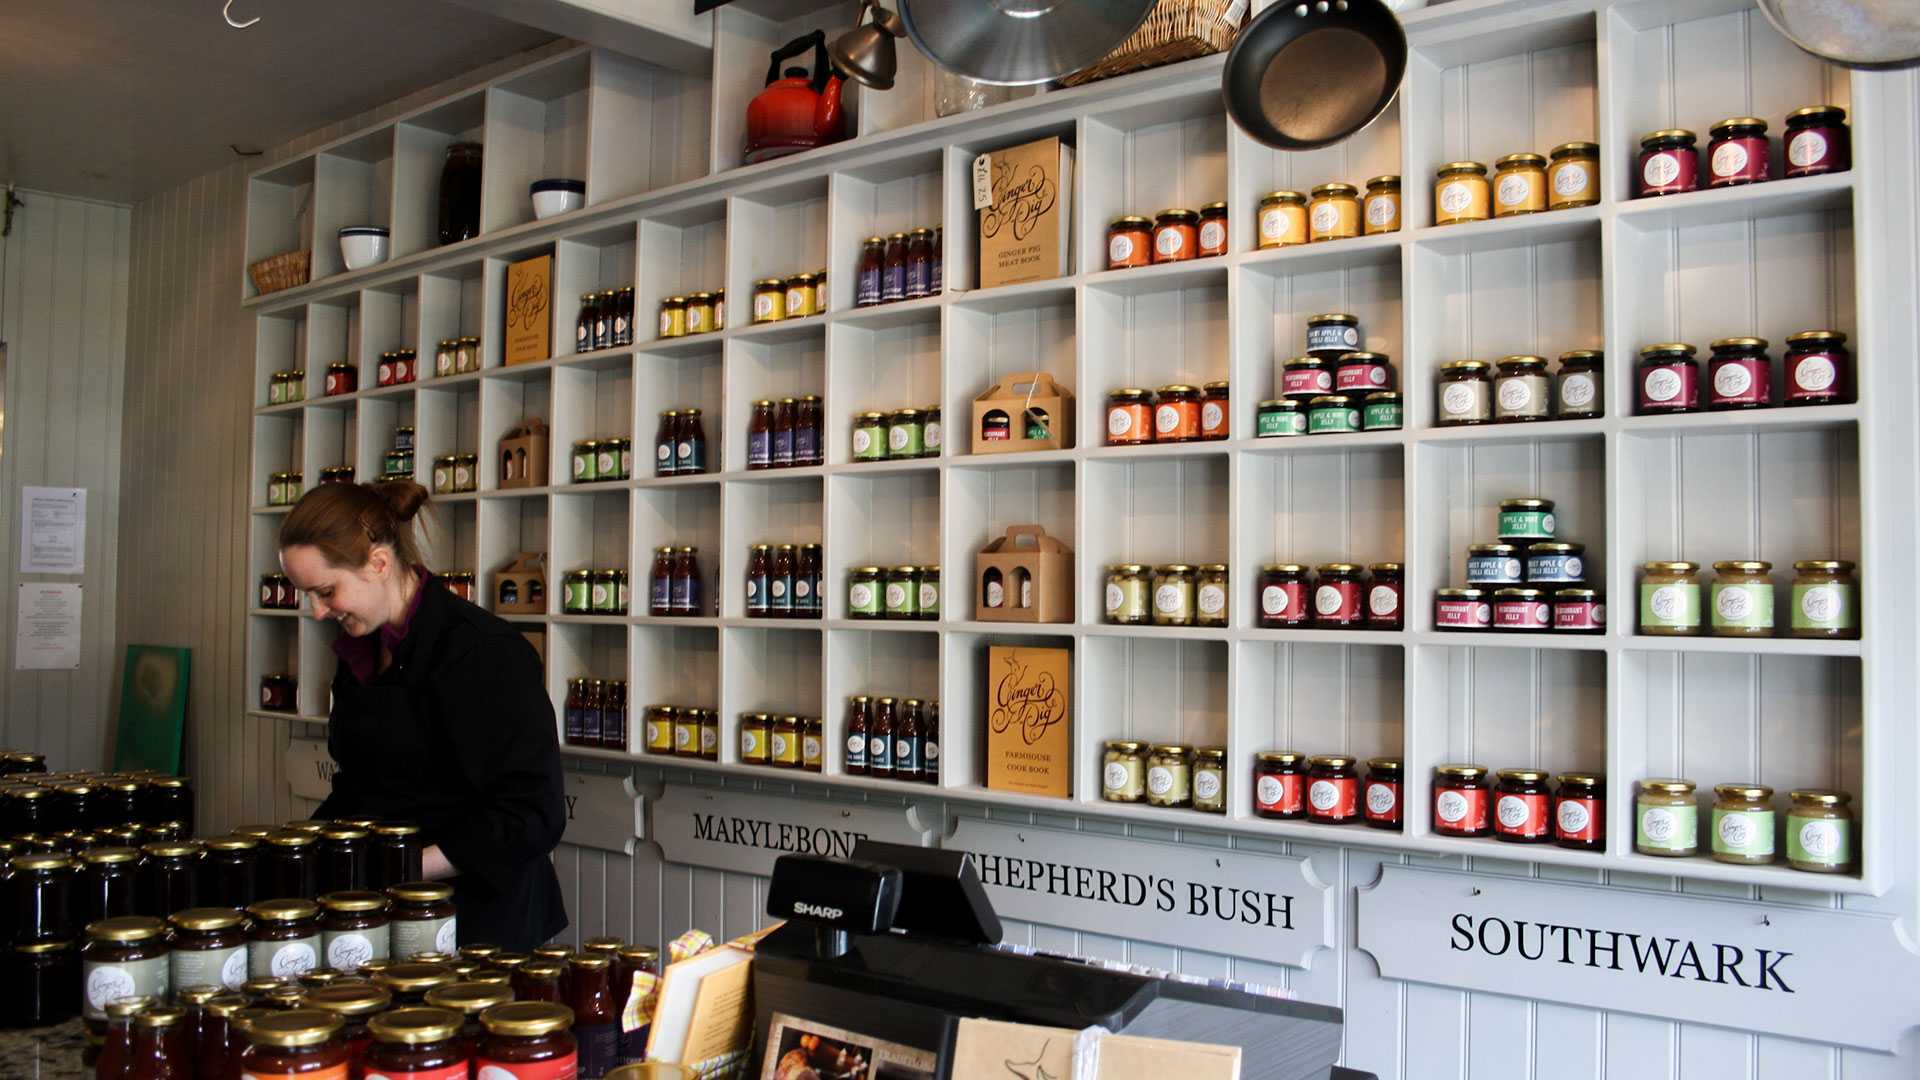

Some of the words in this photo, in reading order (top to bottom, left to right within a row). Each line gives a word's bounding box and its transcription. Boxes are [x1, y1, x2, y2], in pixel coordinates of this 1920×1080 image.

[693, 812, 868, 858] MARYLEBON
[793, 902, 843, 920] SHARP
[966, 851, 1176, 912] HEPHERD'S
[1186, 882, 1295, 931] BUSH
[1450, 912, 1796, 994] SOUTHWARK
